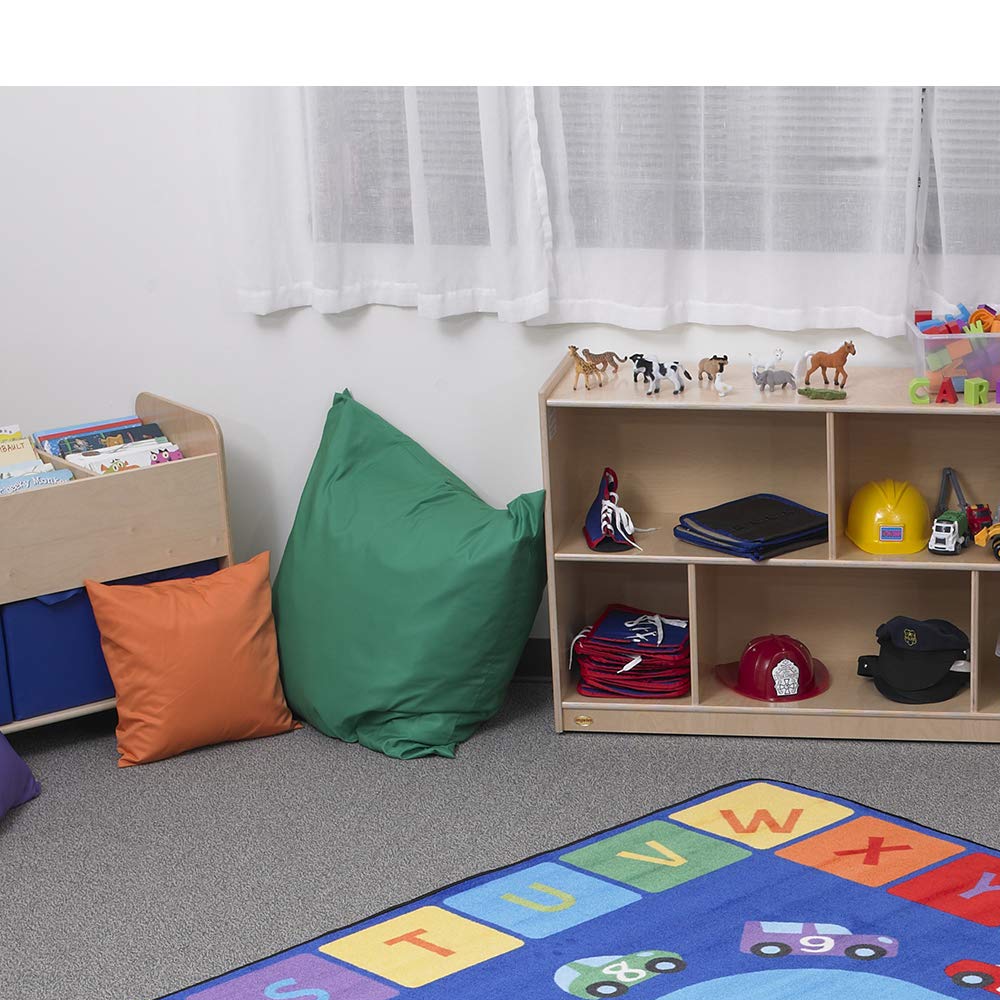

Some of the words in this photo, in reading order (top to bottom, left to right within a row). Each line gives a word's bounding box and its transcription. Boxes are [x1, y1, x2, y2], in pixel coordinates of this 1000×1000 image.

[720, 808, 804, 834] W
[616, 839, 687, 867] V
[833, 836, 913, 865] X
[504, 883, 576, 913] U
[384, 929, 456, 957] T
[799, 935, 835, 953] 9
[602, 960, 647, 983] 8
